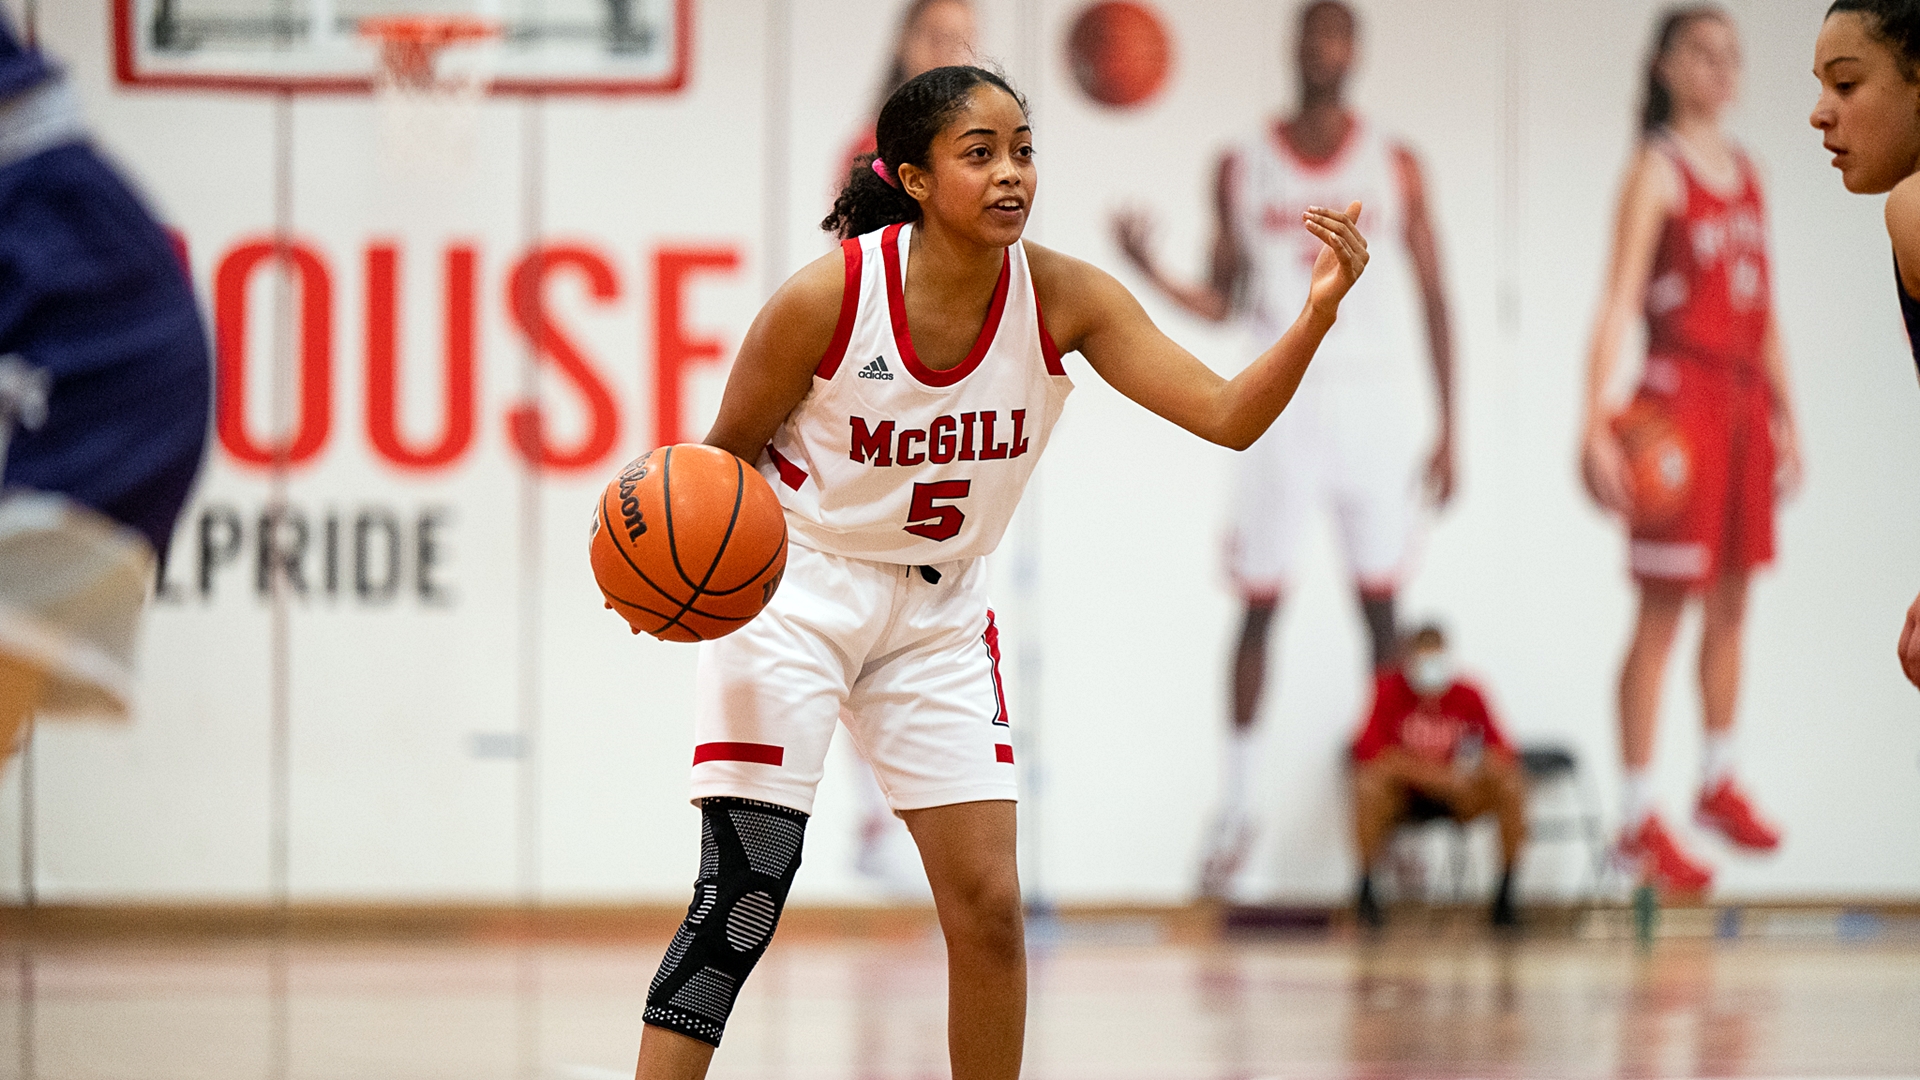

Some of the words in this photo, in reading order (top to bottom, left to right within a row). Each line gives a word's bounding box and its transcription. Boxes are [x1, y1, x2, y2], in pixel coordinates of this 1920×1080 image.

[174, 236, 742, 470] OUSE
[858, 370, 894, 381] adidas
[849, 408, 1030, 468] McGILL
[902, 479, 972, 543] 5
